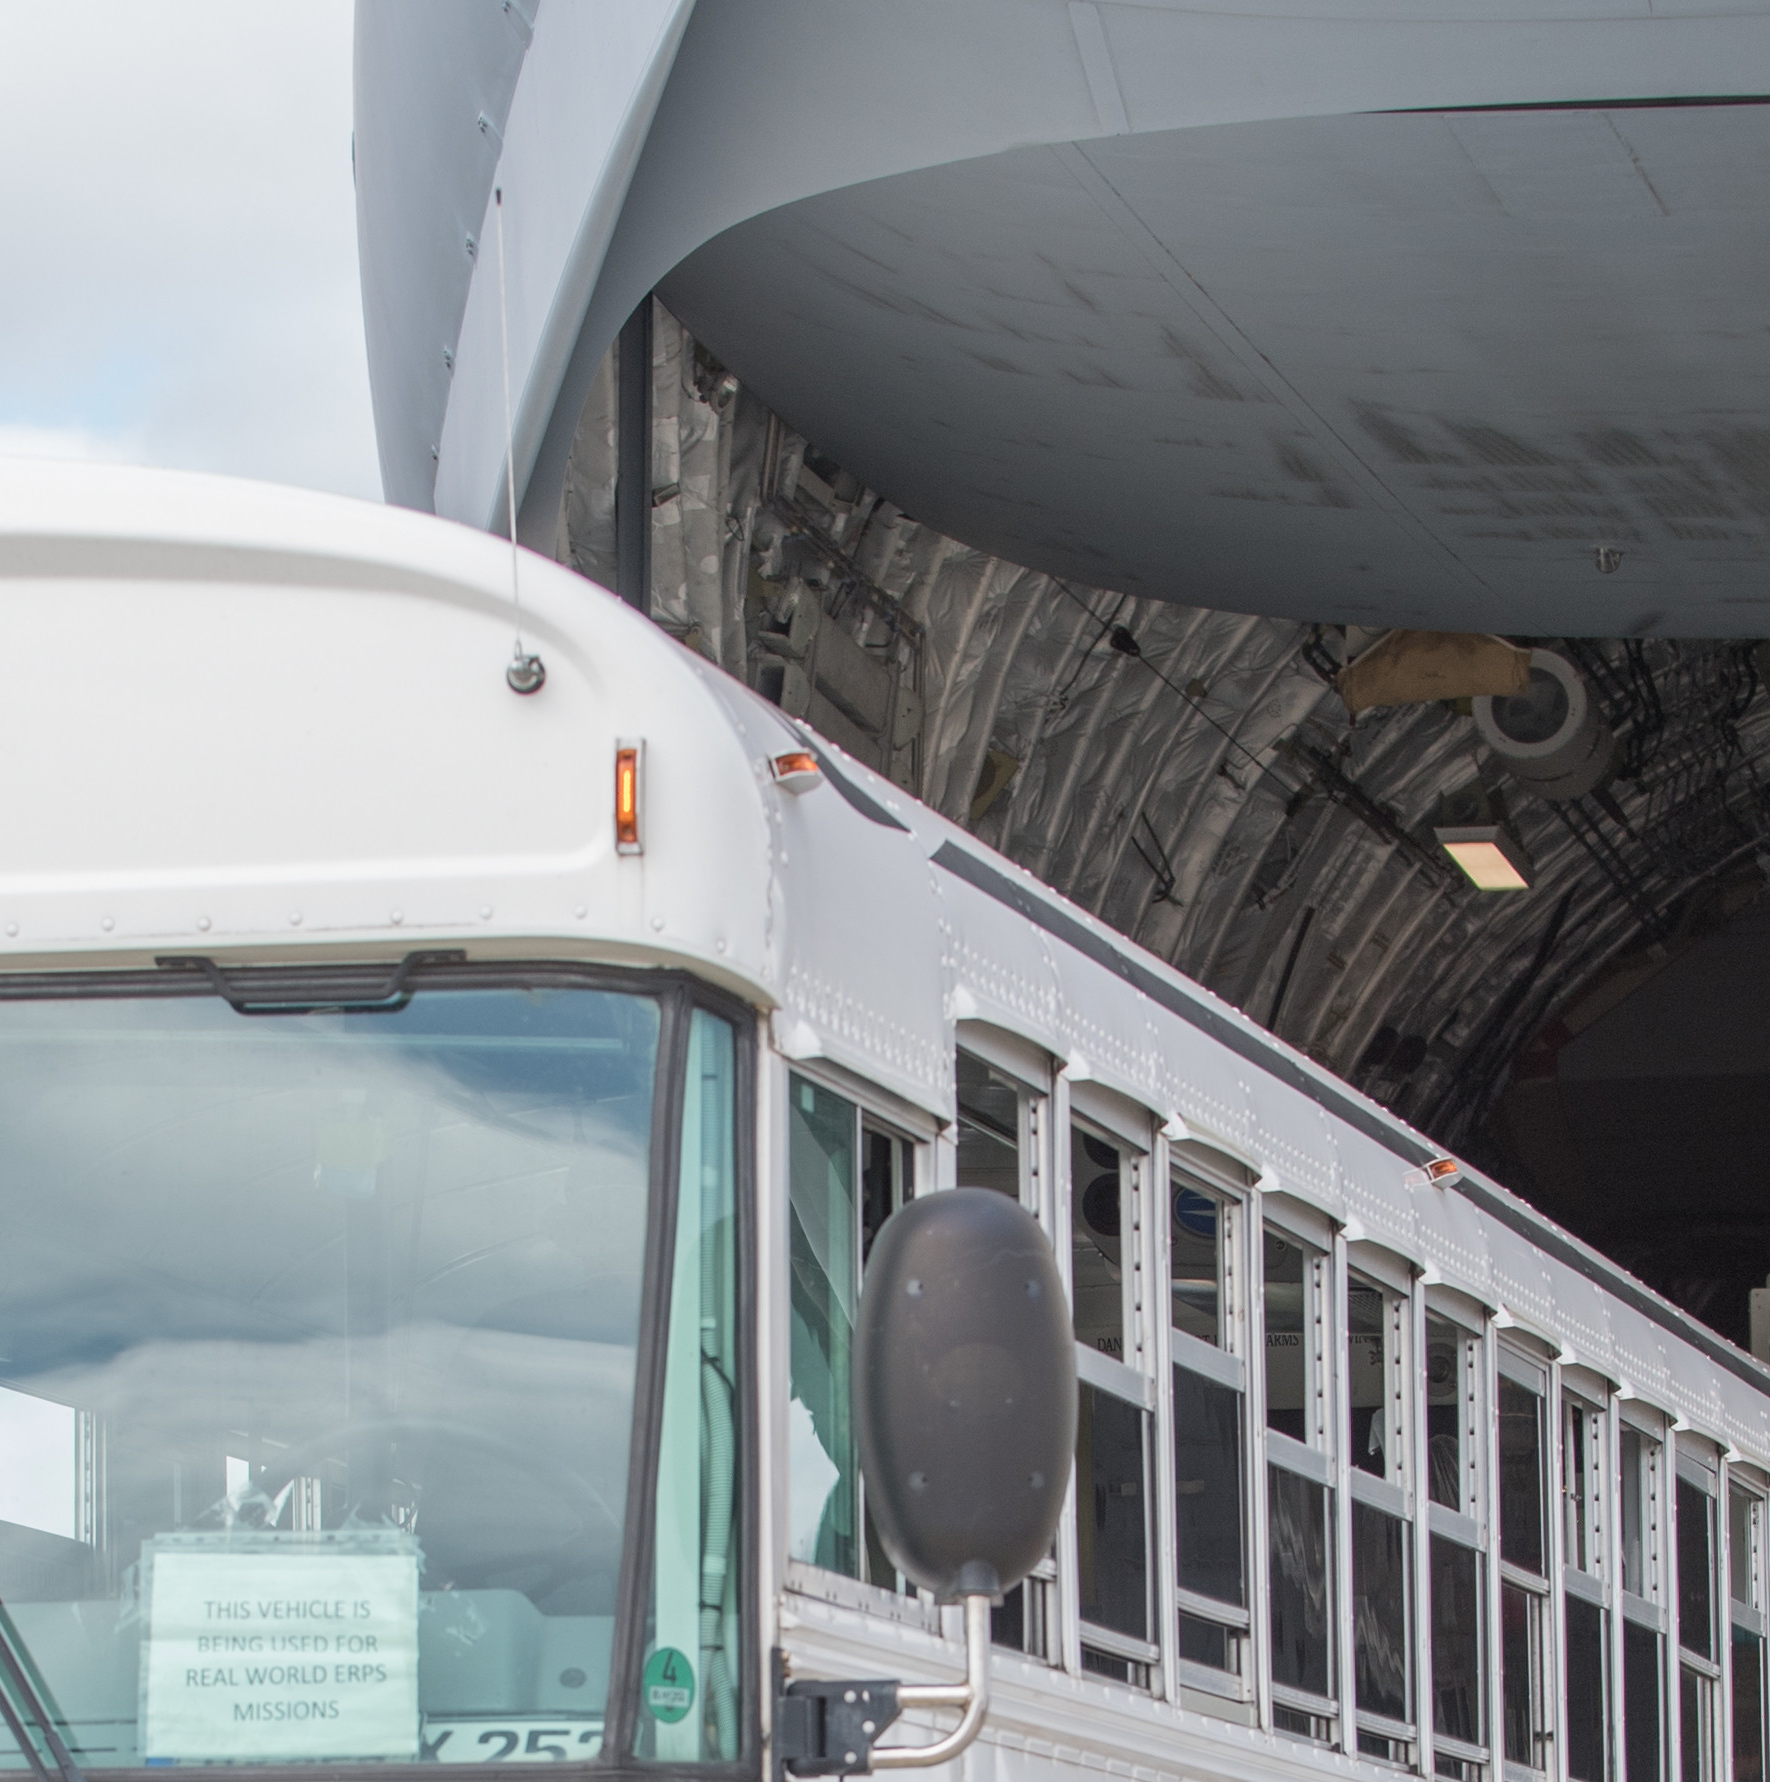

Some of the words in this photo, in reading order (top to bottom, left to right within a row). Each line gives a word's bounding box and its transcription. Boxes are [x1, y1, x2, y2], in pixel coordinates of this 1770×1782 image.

[204, 1600, 251, 1620] THIS
[257, 1600, 345, 1620] VEHICLE
[353, 1600, 371, 1620] IS
[197, 1635, 264, 1653] BEING
[271, 1635, 329, 1653] USED
[336, 1635, 378, 1653] FOR
[186, 1667, 239, 1688] REAL
[245, 1664, 327, 1686] WORLD
[335, 1663, 388, 1684] ERPS
[233, 1700, 340, 1722] MISSIONS
